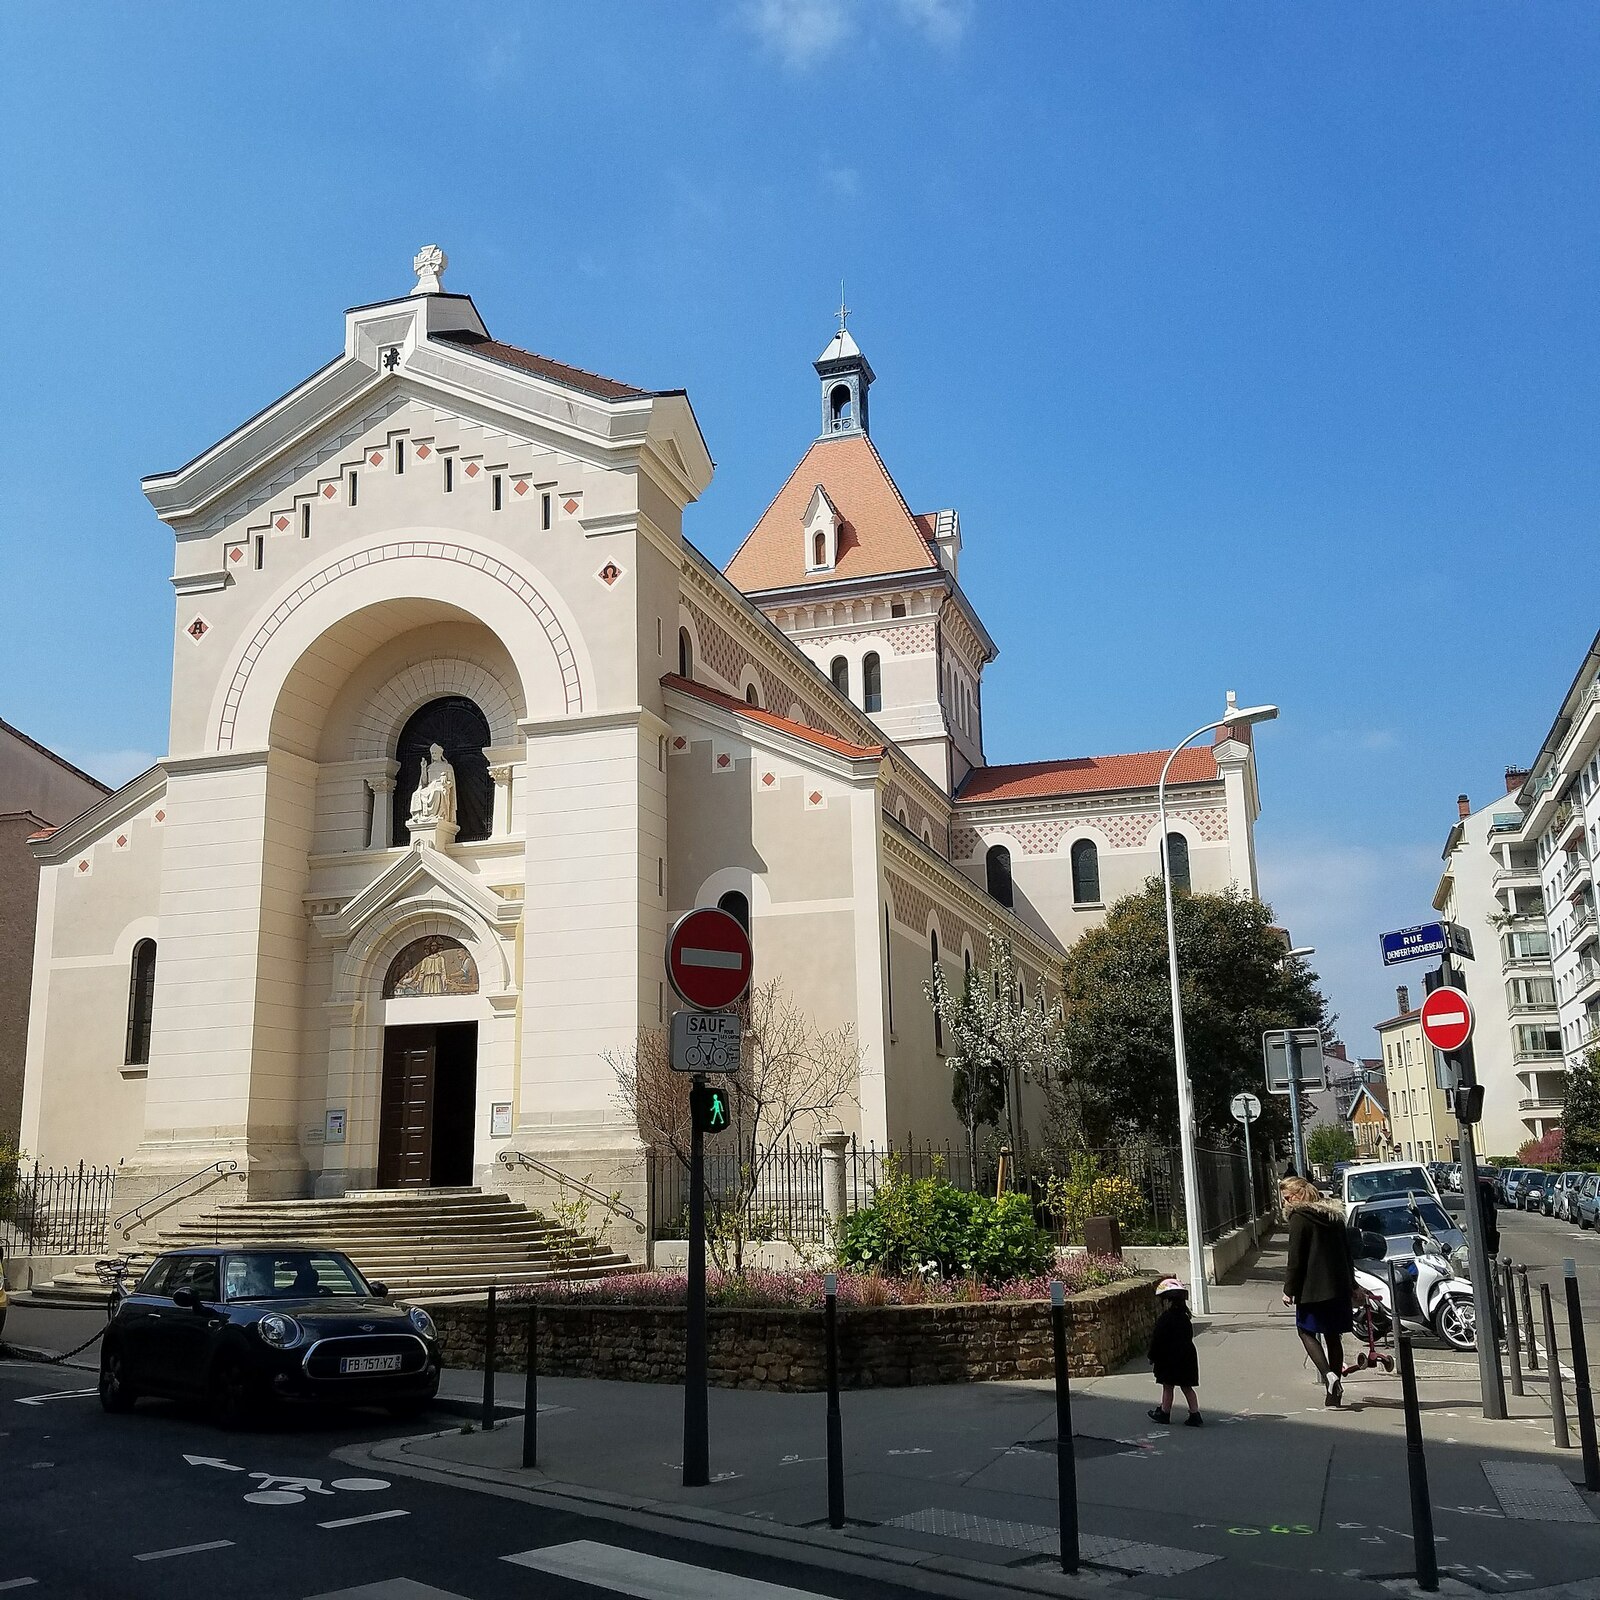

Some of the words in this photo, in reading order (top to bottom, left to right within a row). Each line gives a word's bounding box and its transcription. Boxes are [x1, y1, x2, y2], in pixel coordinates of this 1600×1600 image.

[1403, 934, 1423, 946] RUE
[1386, 940, 1444, 960] DENFERT-ROCHEREAU
[689, 1017, 726, 1033] SAUF
